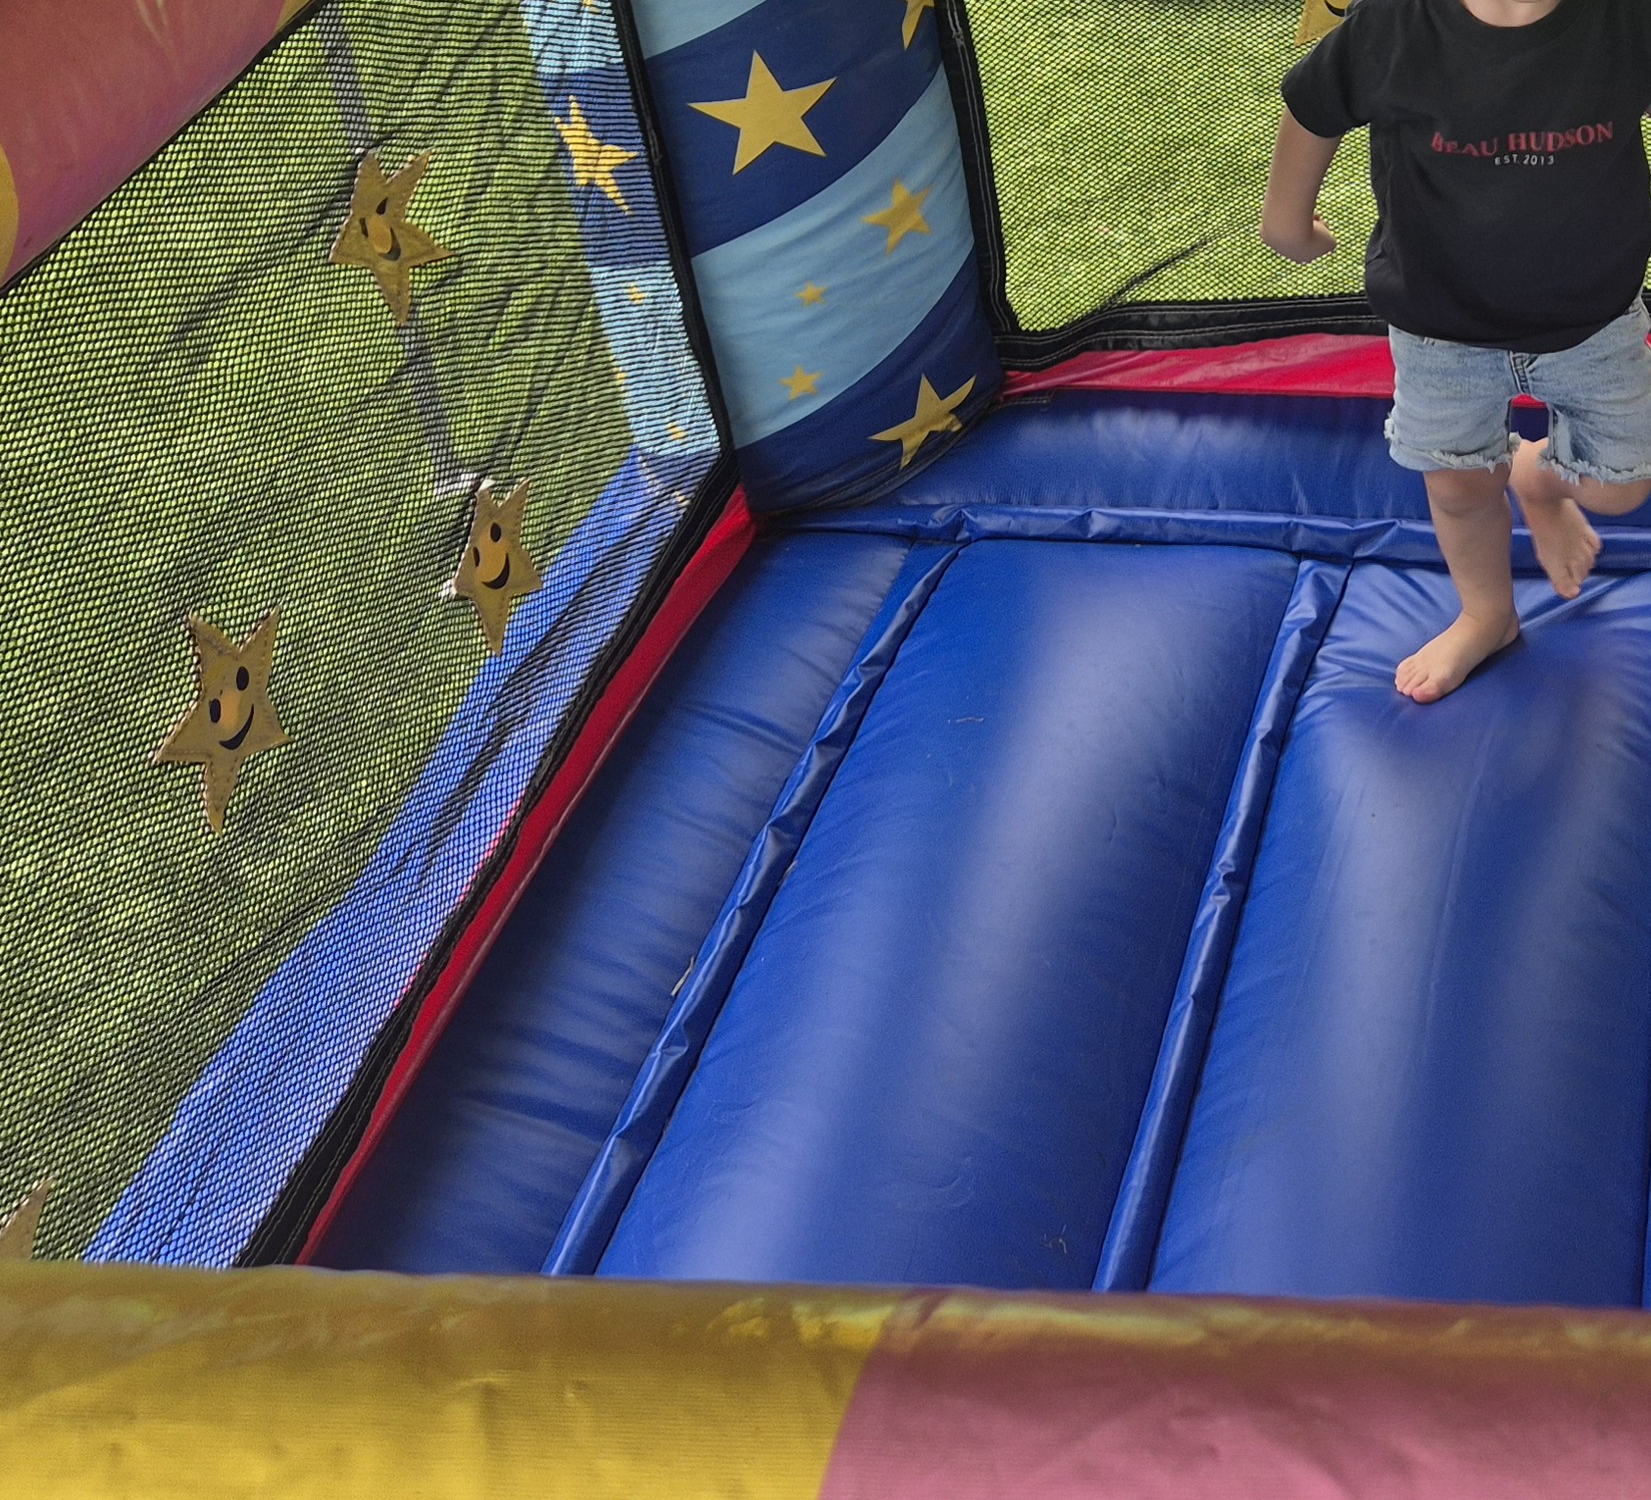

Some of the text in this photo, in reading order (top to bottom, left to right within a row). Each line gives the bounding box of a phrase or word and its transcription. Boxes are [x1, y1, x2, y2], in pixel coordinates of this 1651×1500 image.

[1507, 121, 1614, 153] HUDSON
[1494, 154, 1555, 166] EST. 2013
